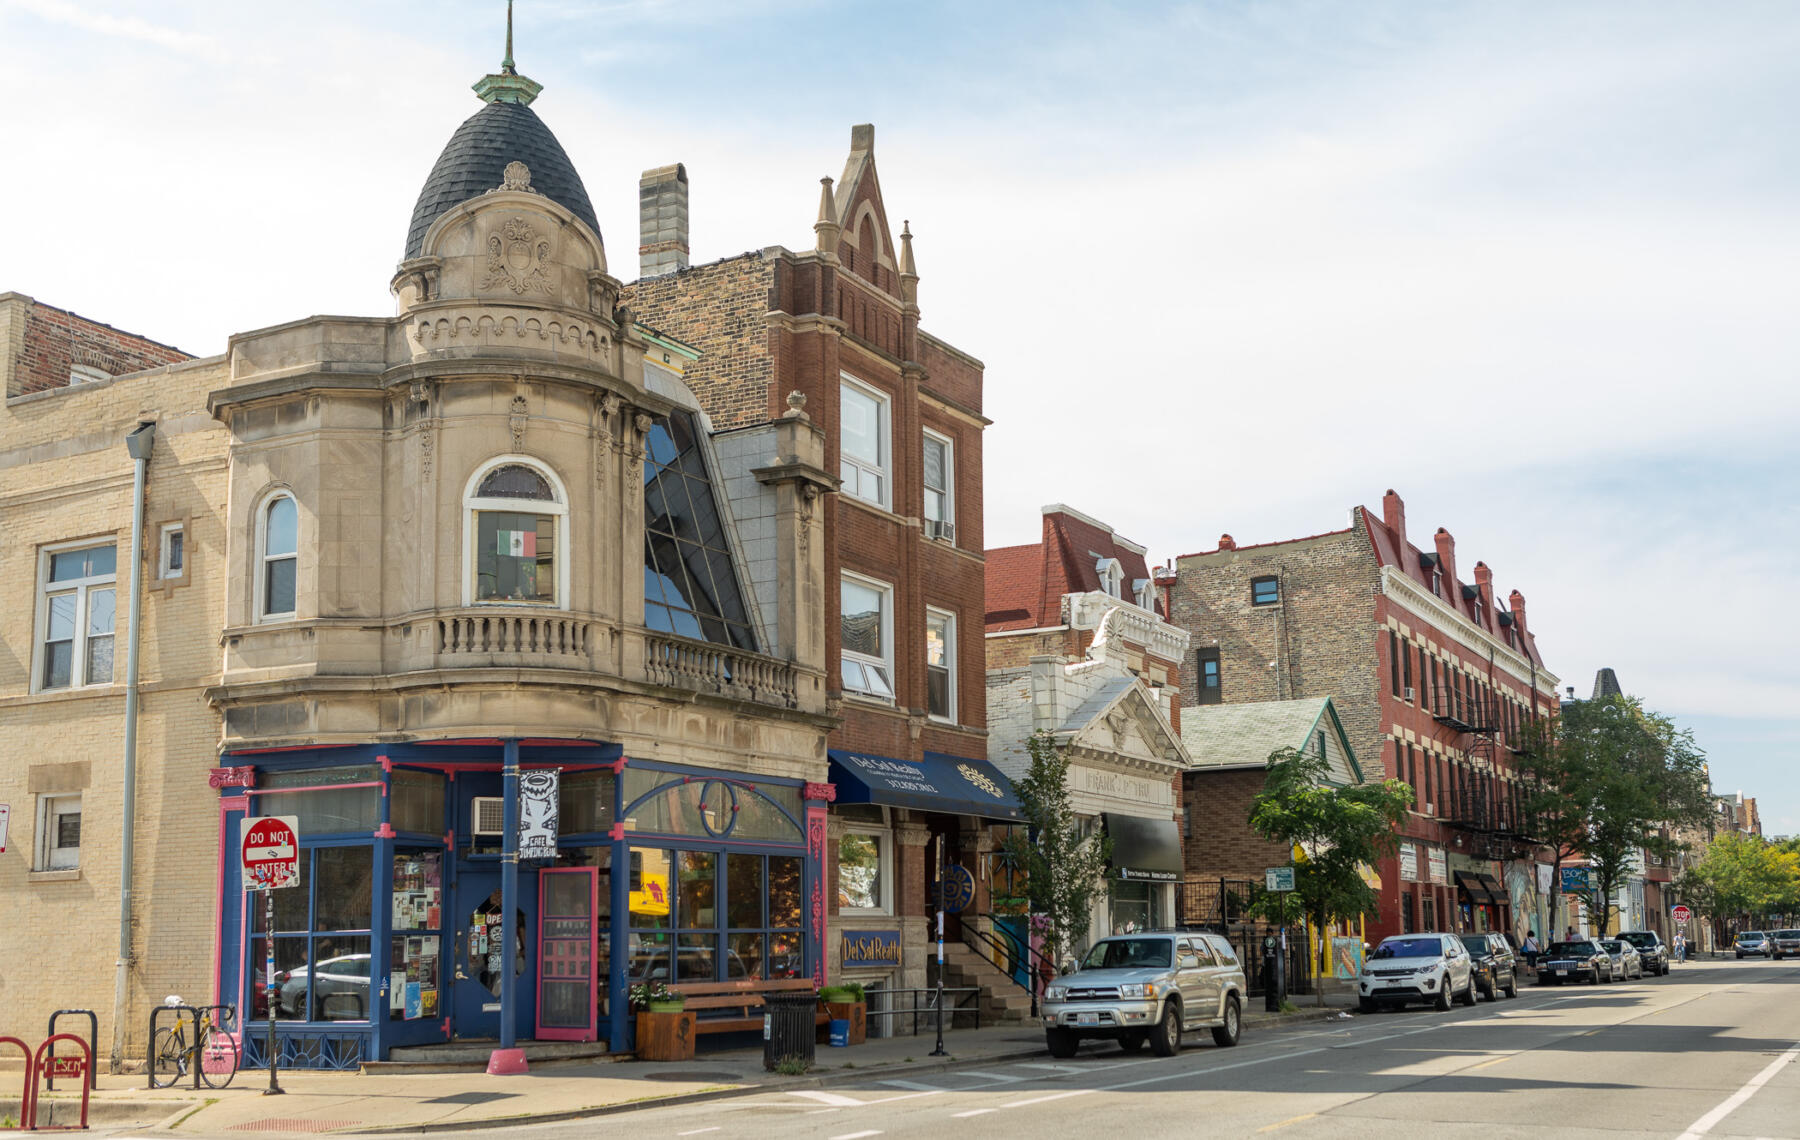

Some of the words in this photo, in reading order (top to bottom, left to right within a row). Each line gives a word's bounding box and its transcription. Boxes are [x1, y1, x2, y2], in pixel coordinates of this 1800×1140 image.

[848, 755, 875, 769] Del
[1087, 773, 1116, 793] FRANK
[1123, 779, 1149, 798] PTRU
[250, 832, 264, 844] DO
[270, 831, 290, 842] NOT
[529, 836, 546, 847] CAFE
[255, 862, 286, 878] ENTER
[486, 914, 503, 924] OPE
[1673, 910, 1690, 919] STOP
[843, 937, 858, 960] Del
[859, 937, 874, 960] Sol
[874, 937, 902, 965] Realty
